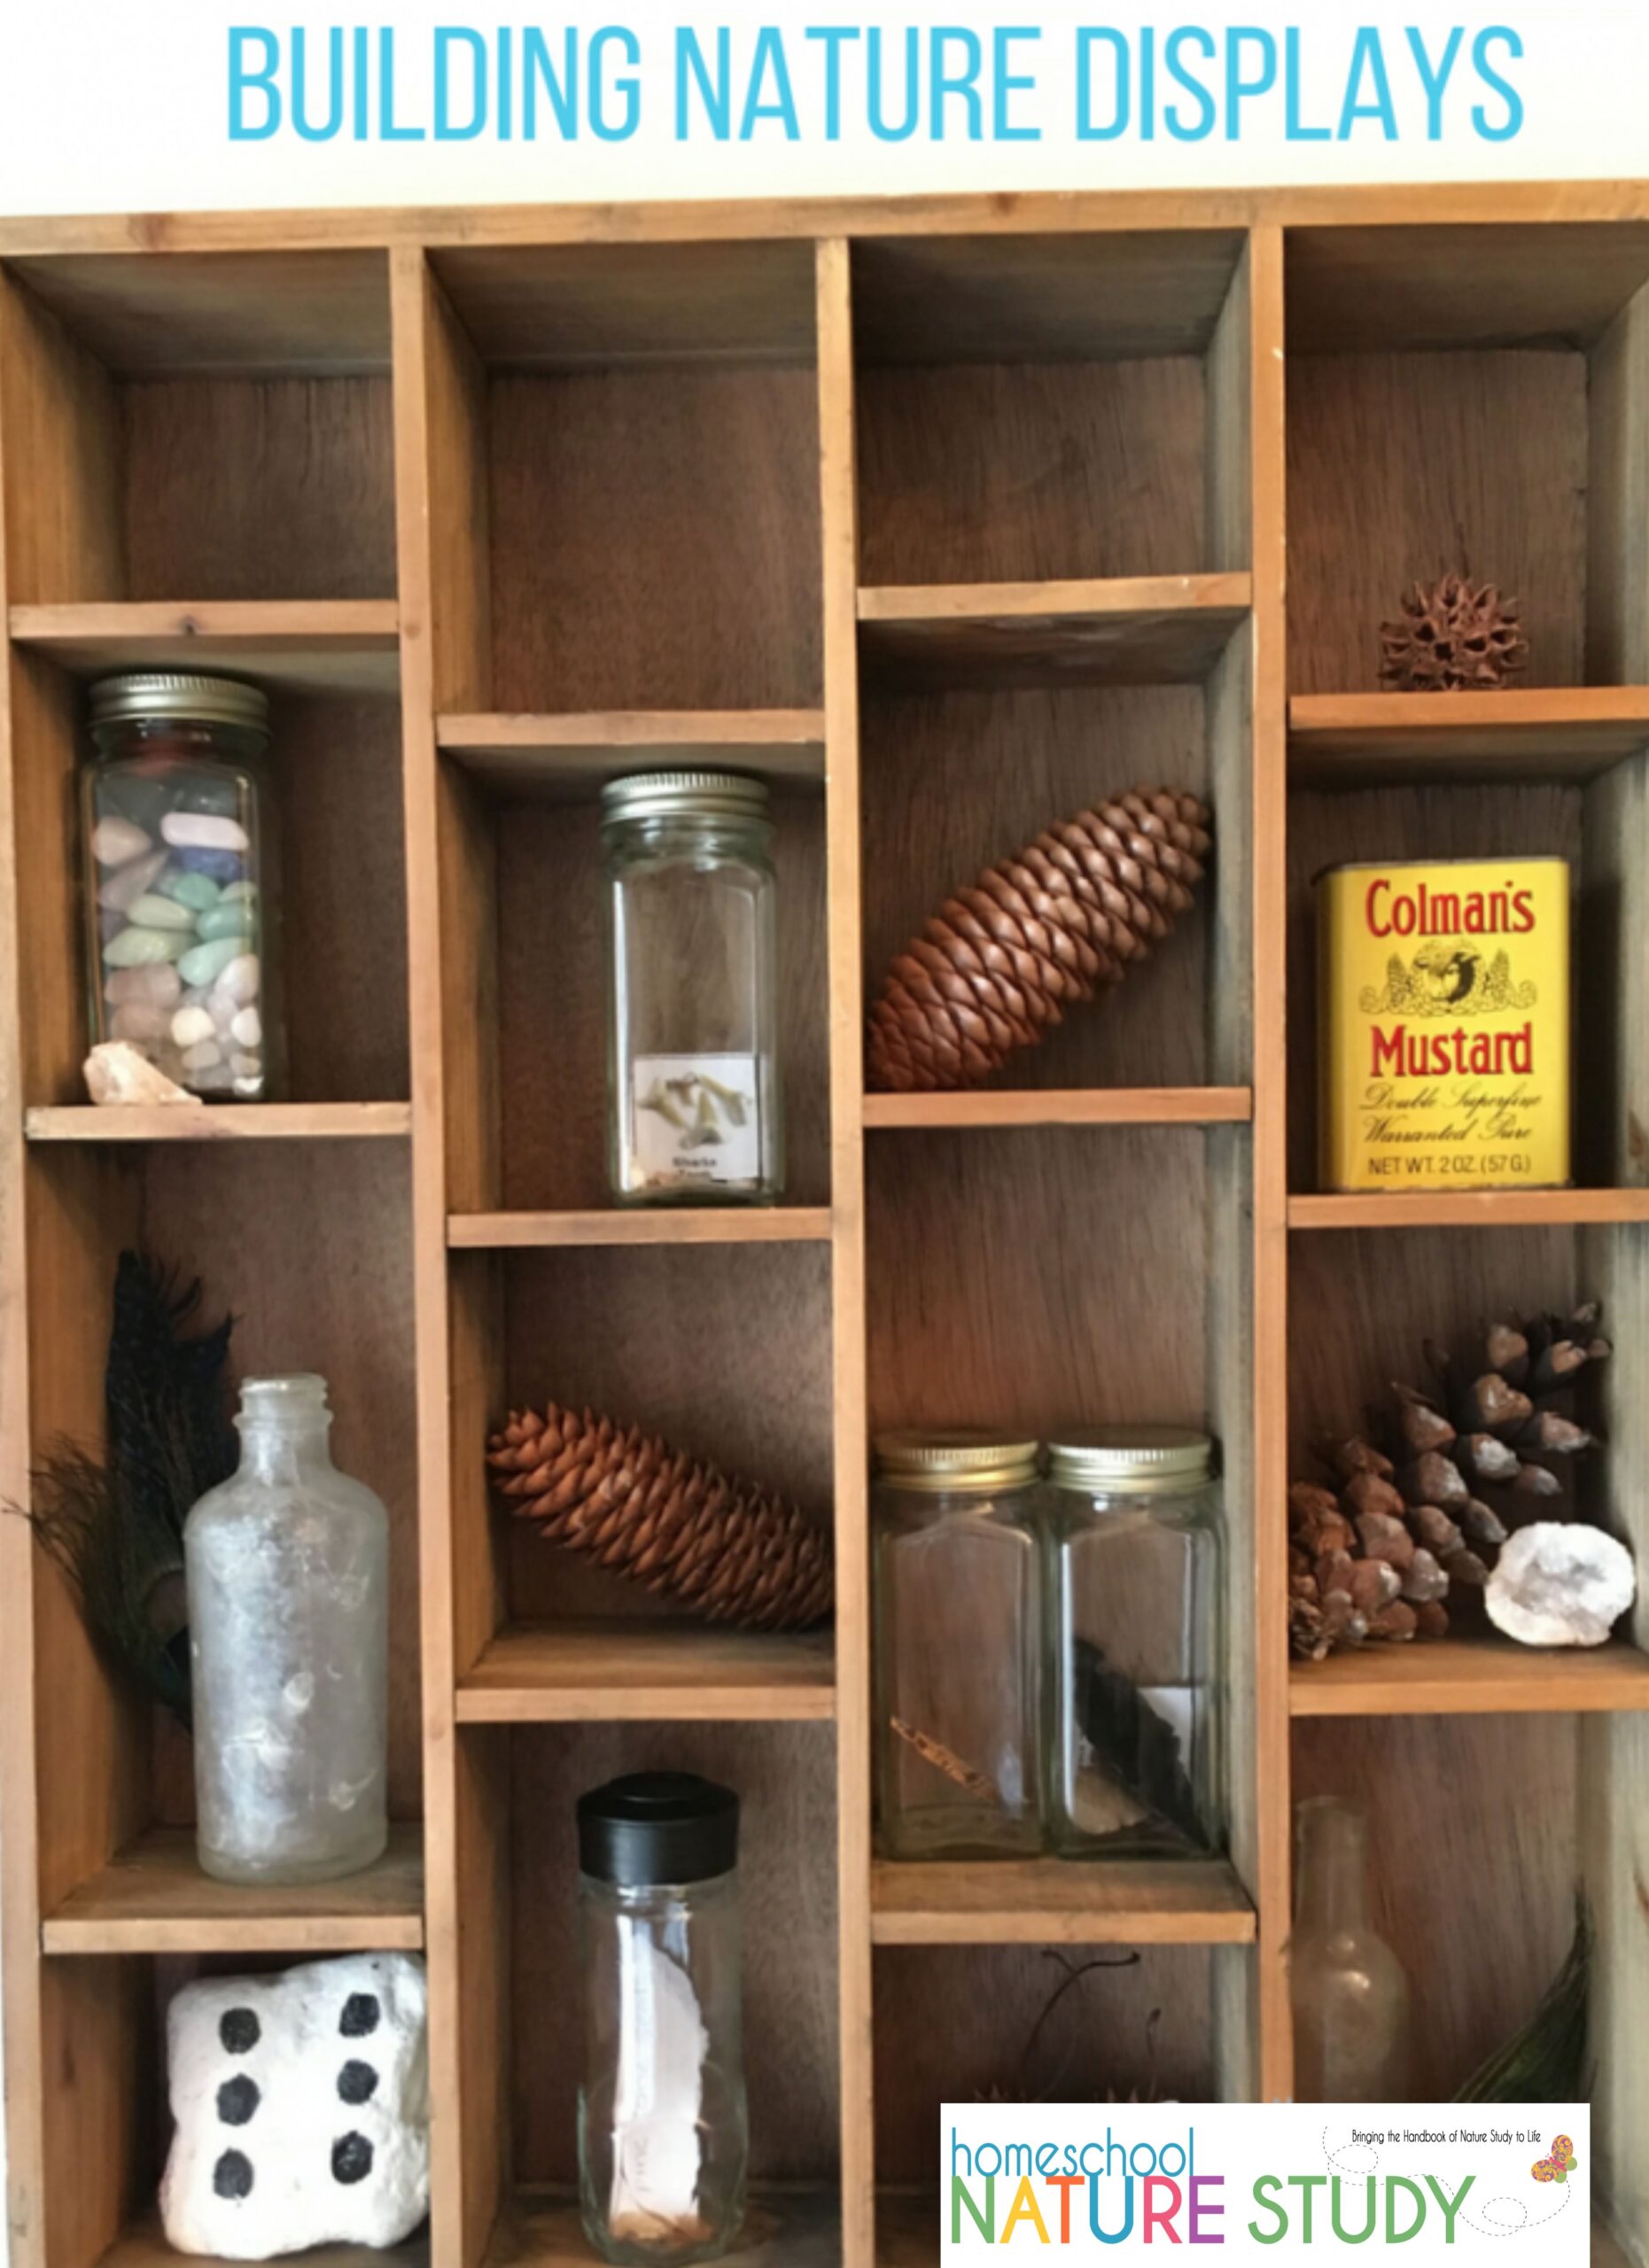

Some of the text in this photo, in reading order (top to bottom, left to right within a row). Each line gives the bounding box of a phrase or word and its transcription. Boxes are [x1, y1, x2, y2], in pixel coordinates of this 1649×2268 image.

[1365, 879, 1535, 937] Colman's
[1370, 1021, 1533, 1077] Mustard
[1368, 1156, 1401, 1176] NET
